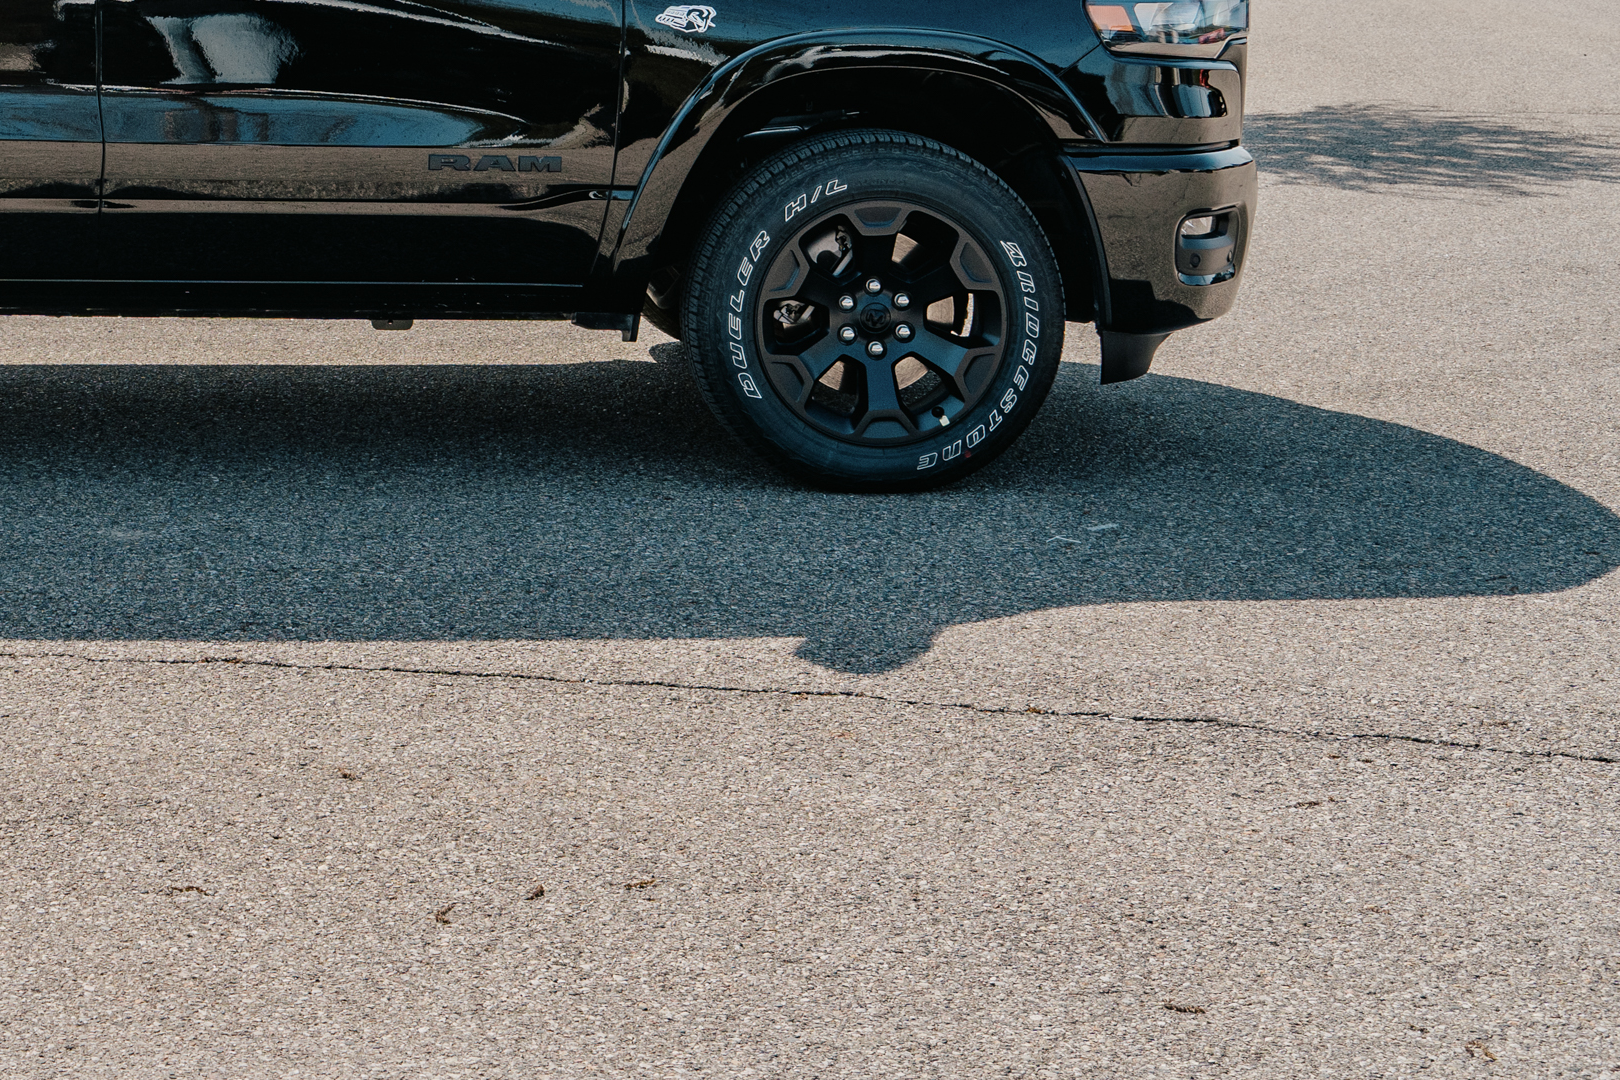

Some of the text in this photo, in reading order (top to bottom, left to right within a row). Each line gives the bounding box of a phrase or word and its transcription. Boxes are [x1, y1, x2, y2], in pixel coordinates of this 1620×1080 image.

[428, 154, 562, 172] RAM
[727, 178, 848, 399] DUELER H/L
[916, 240, 1040, 470] BRIDGESTONE
